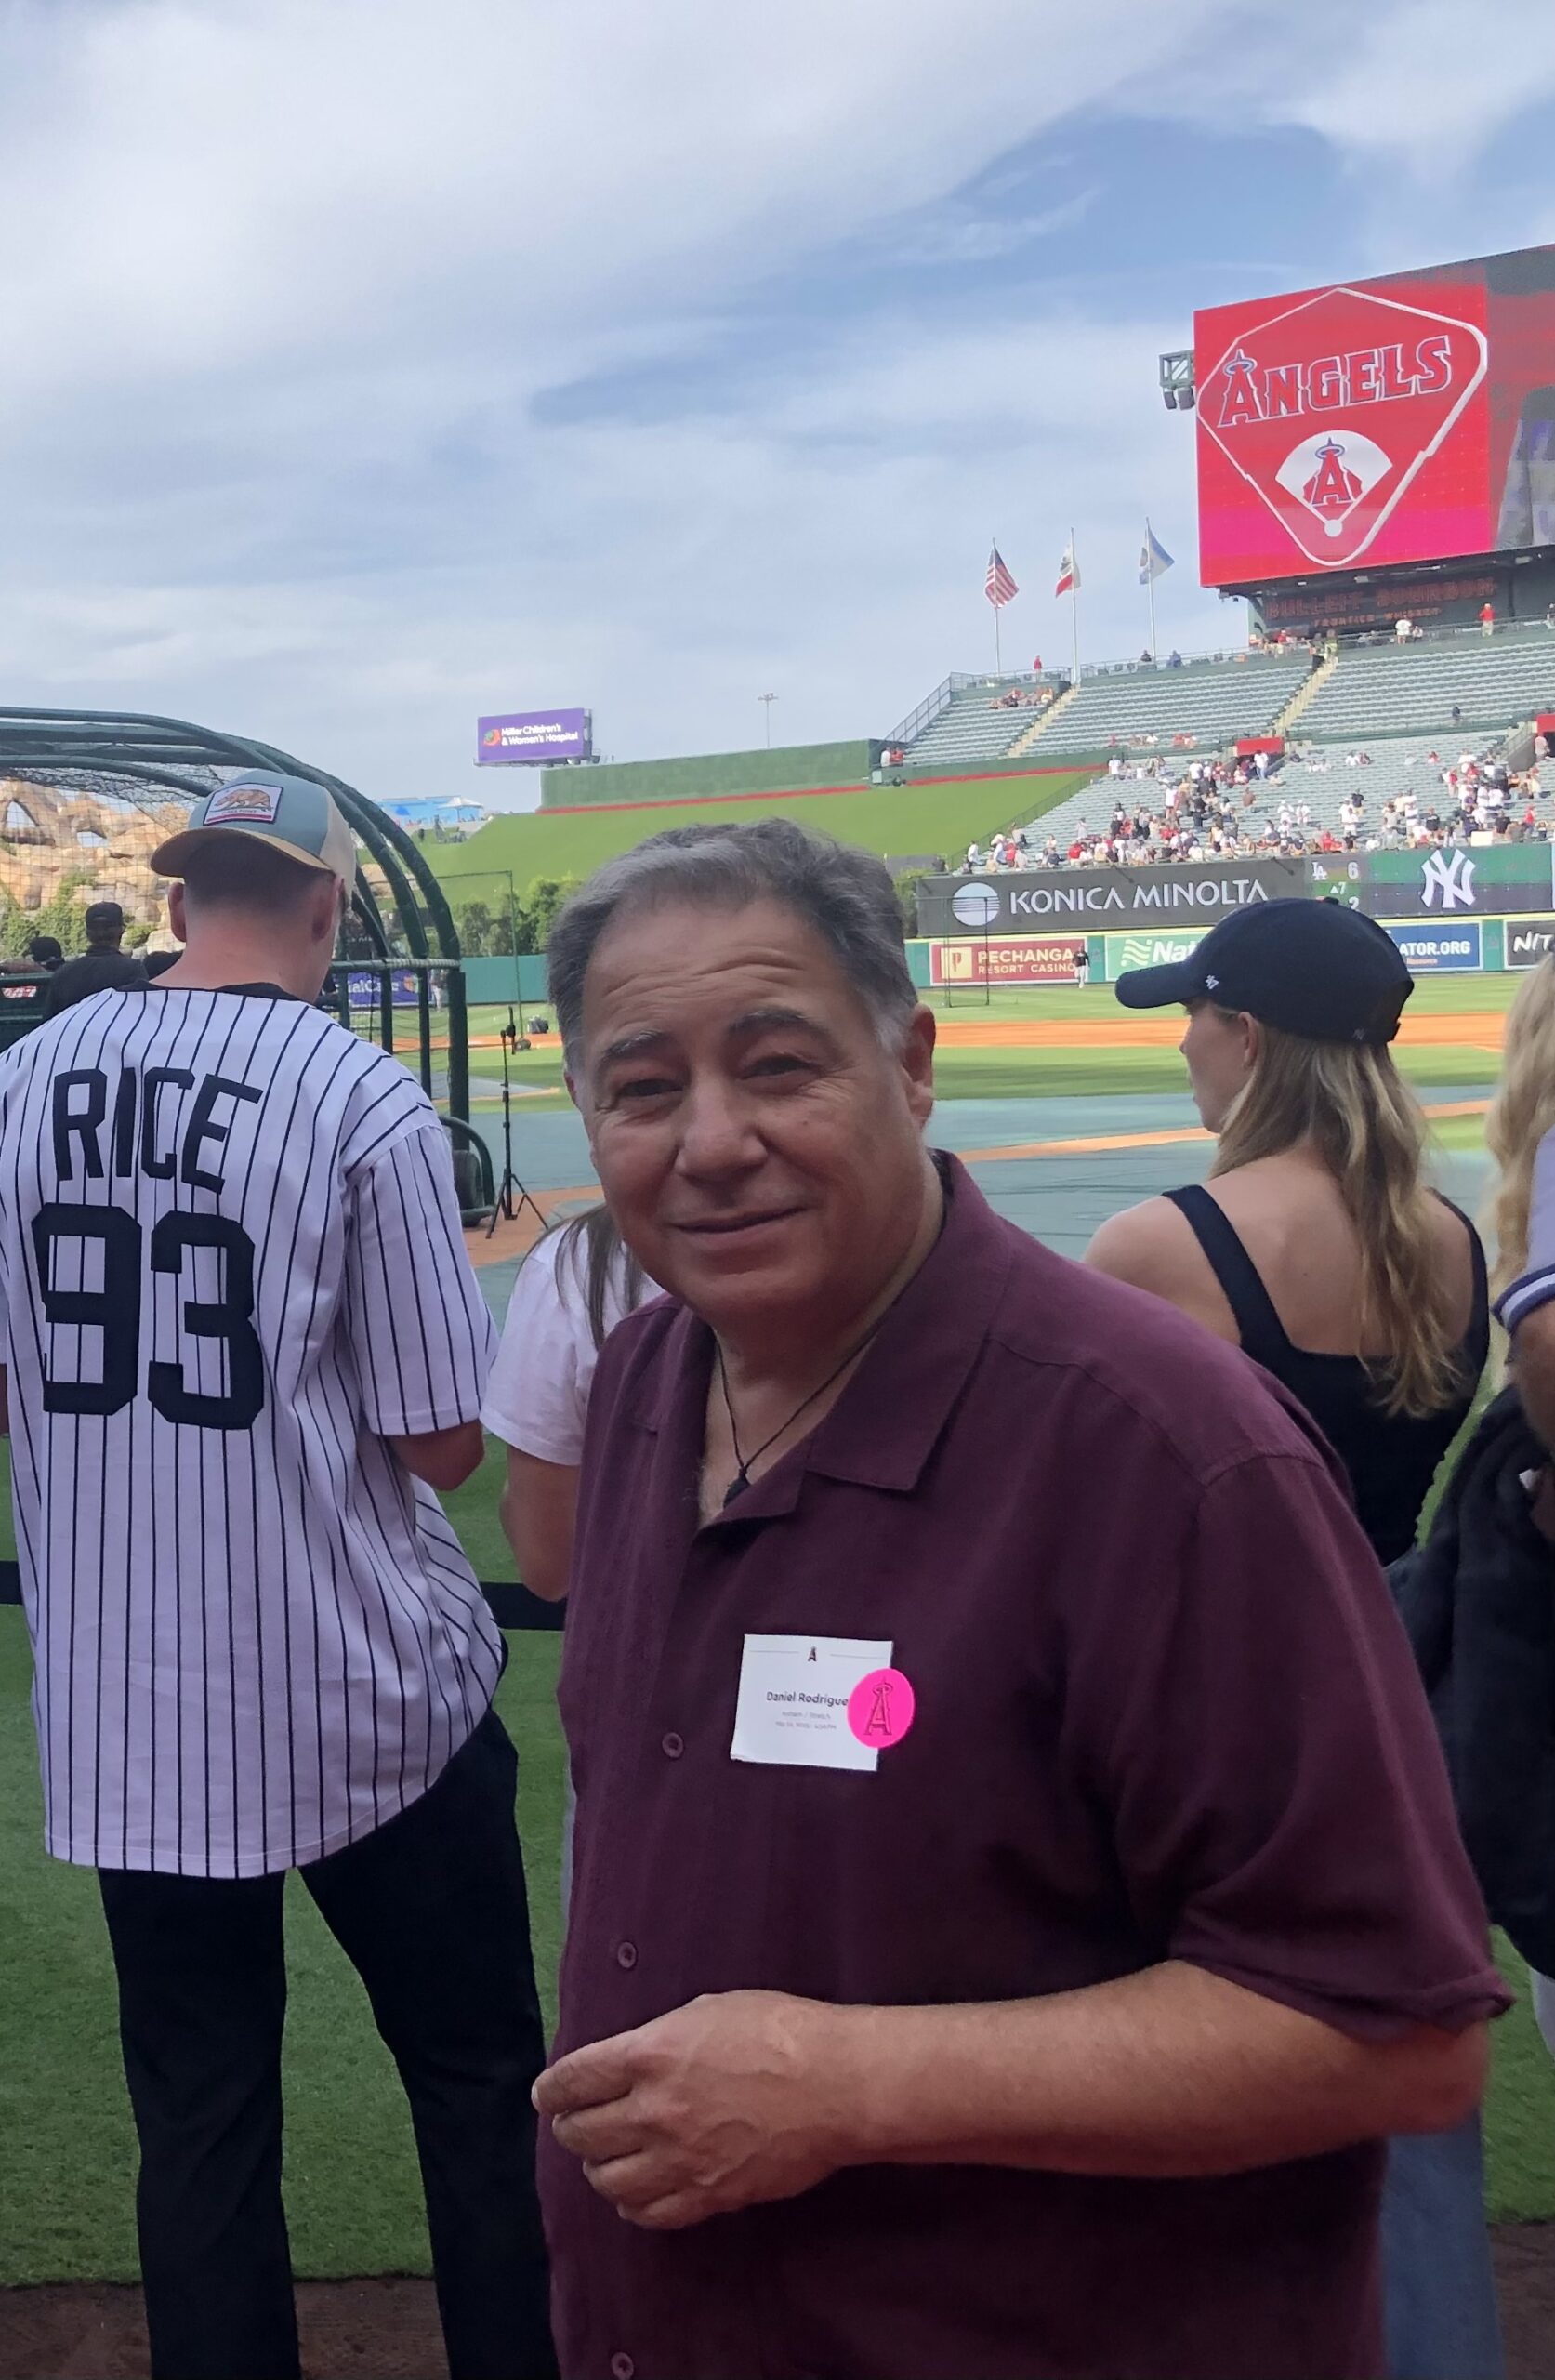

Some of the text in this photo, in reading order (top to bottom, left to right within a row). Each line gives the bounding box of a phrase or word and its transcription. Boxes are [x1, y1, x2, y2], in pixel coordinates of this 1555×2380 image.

[1218, 335, 1452, 428] ANGELS
[546, 732, 578, 743] Hospital
[1348, 862, 1359, 879] 6
[1420, 849, 1476, 908] NY
[1010, 879, 1269, 915] KONICA MINOLTA
[978, 948, 1074, 964] PECHANGA
[1153, 940, 1197, 962] Nat
[1399, 941, 1471, 956] ATOR.ORG
[979, 963, 1075, 974] RESORT CASINO
[53, 1067, 264, 1195] RICE
[31, 1202, 265, 1430] 93
[766, 1691, 849, 1707] Daniel Rodrigue
